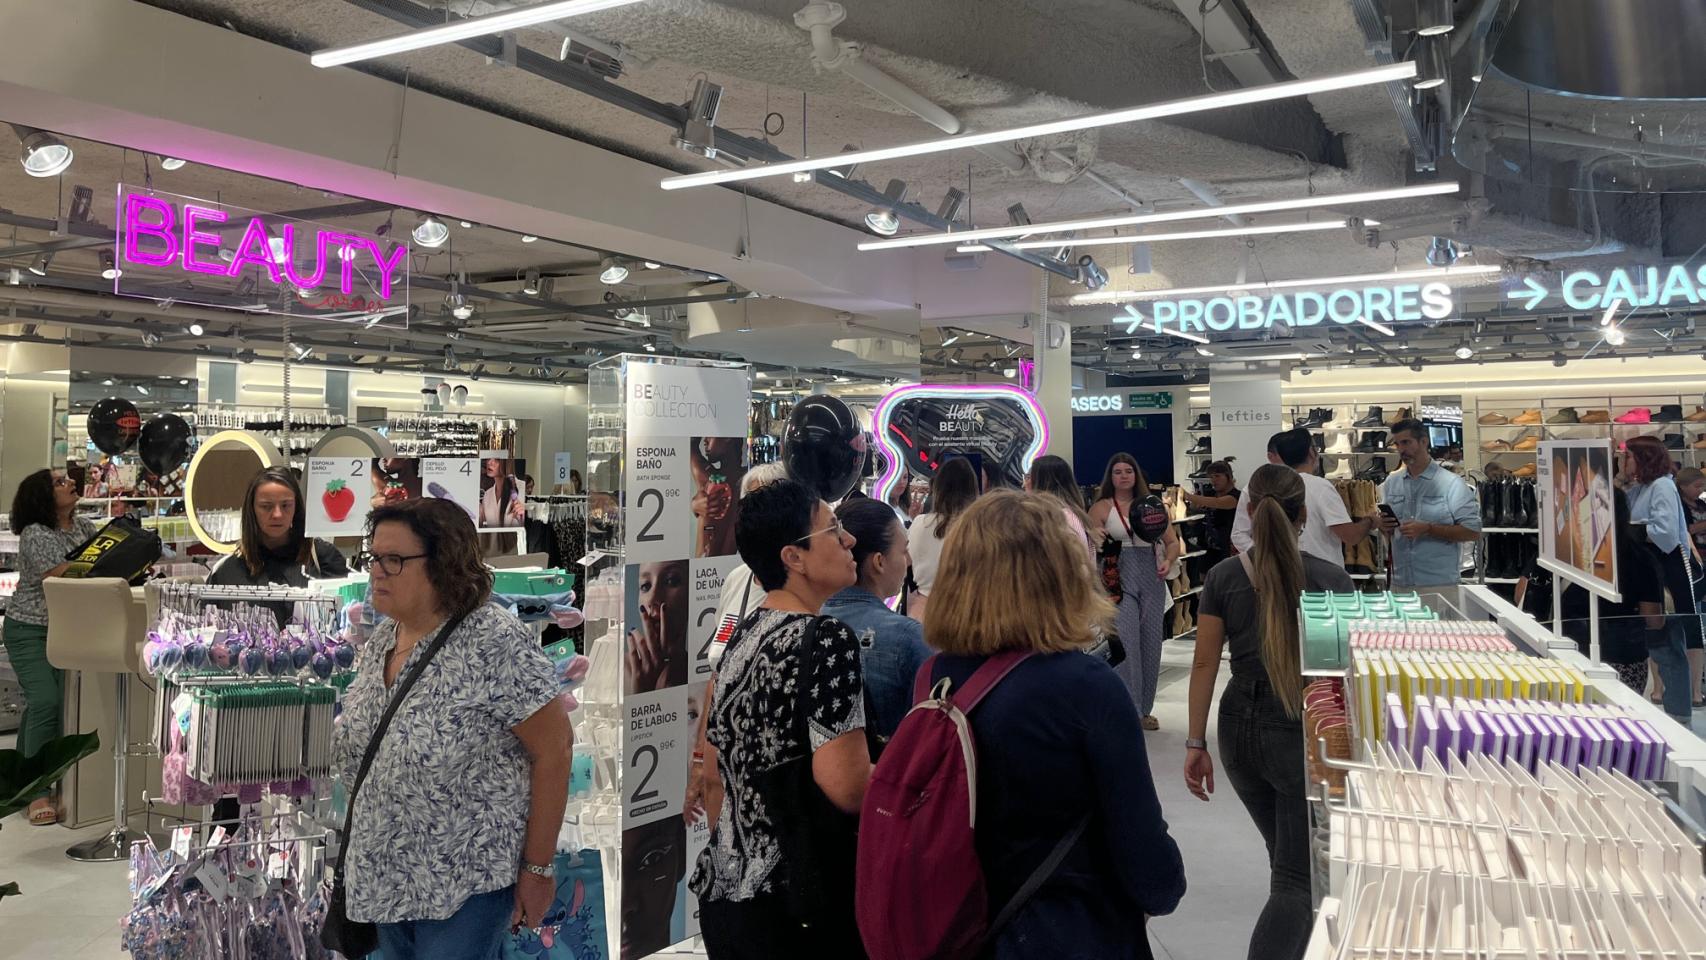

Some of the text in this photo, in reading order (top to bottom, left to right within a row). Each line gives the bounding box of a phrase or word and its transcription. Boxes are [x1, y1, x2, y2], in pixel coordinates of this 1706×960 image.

[126, 193, 407, 299] BEAUTY
[1153, 282, 1453, 334] PROBADORES
[634, 384, 689, 401] BEAUTY
[634, 401, 718, 419] COLLECTION
[1071, 394, 1123, 411] ASEOS
[945, 403, 979, 420] Hello
[1221, 409, 1271, 422] lefties
[939, 420, 985, 432] BEAUTY
[636, 447, 676, 458] ESPONJA
[351, 459, 363, 477] 2
[459, 460, 472, 477] 4
[636, 457, 662, 469] BAÑO
[559, 466, 566, 479] 8
[636, 488, 680, 542] 2 99€
[696, 567, 718, 579] LACA
[696, 576, 725, 591] DE UÑA
[631, 703, 662, 718] BARRA
[631, 711, 678, 731] DE LABIOS
[630, 739, 676, 804] 2 99€
[693, 821, 708, 833] DEL
